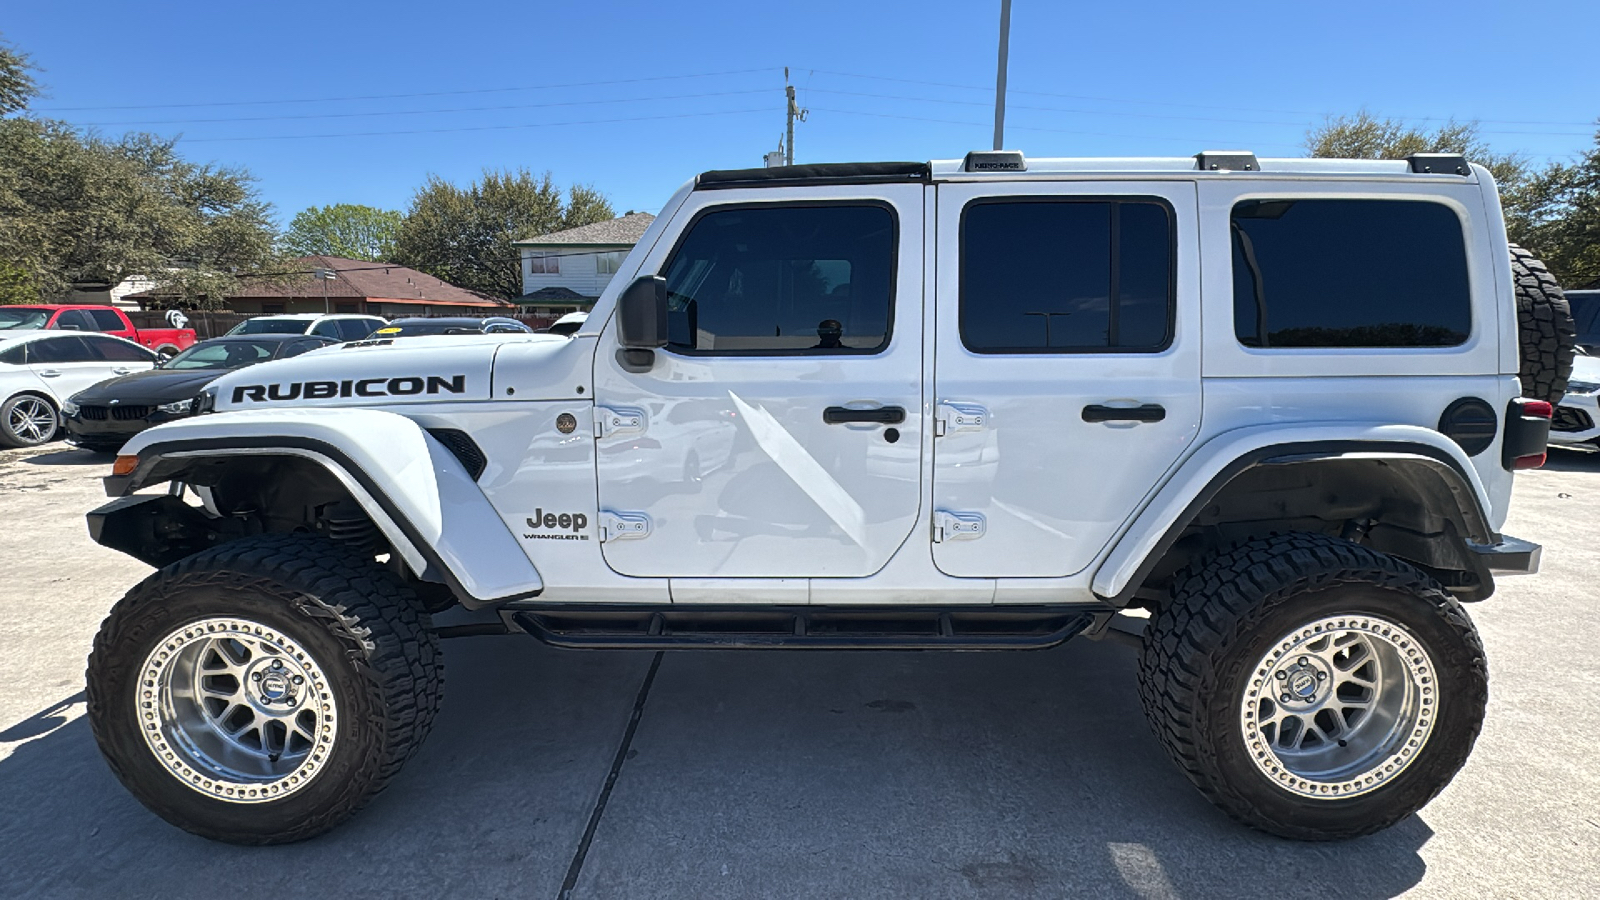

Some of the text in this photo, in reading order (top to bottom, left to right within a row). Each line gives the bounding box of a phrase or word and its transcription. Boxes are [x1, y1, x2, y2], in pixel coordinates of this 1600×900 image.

[231, 375, 466, 403] RUBICON
[526, 508, 587, 532] Jeep
[523, 533, 579, 541] WRANGLER
